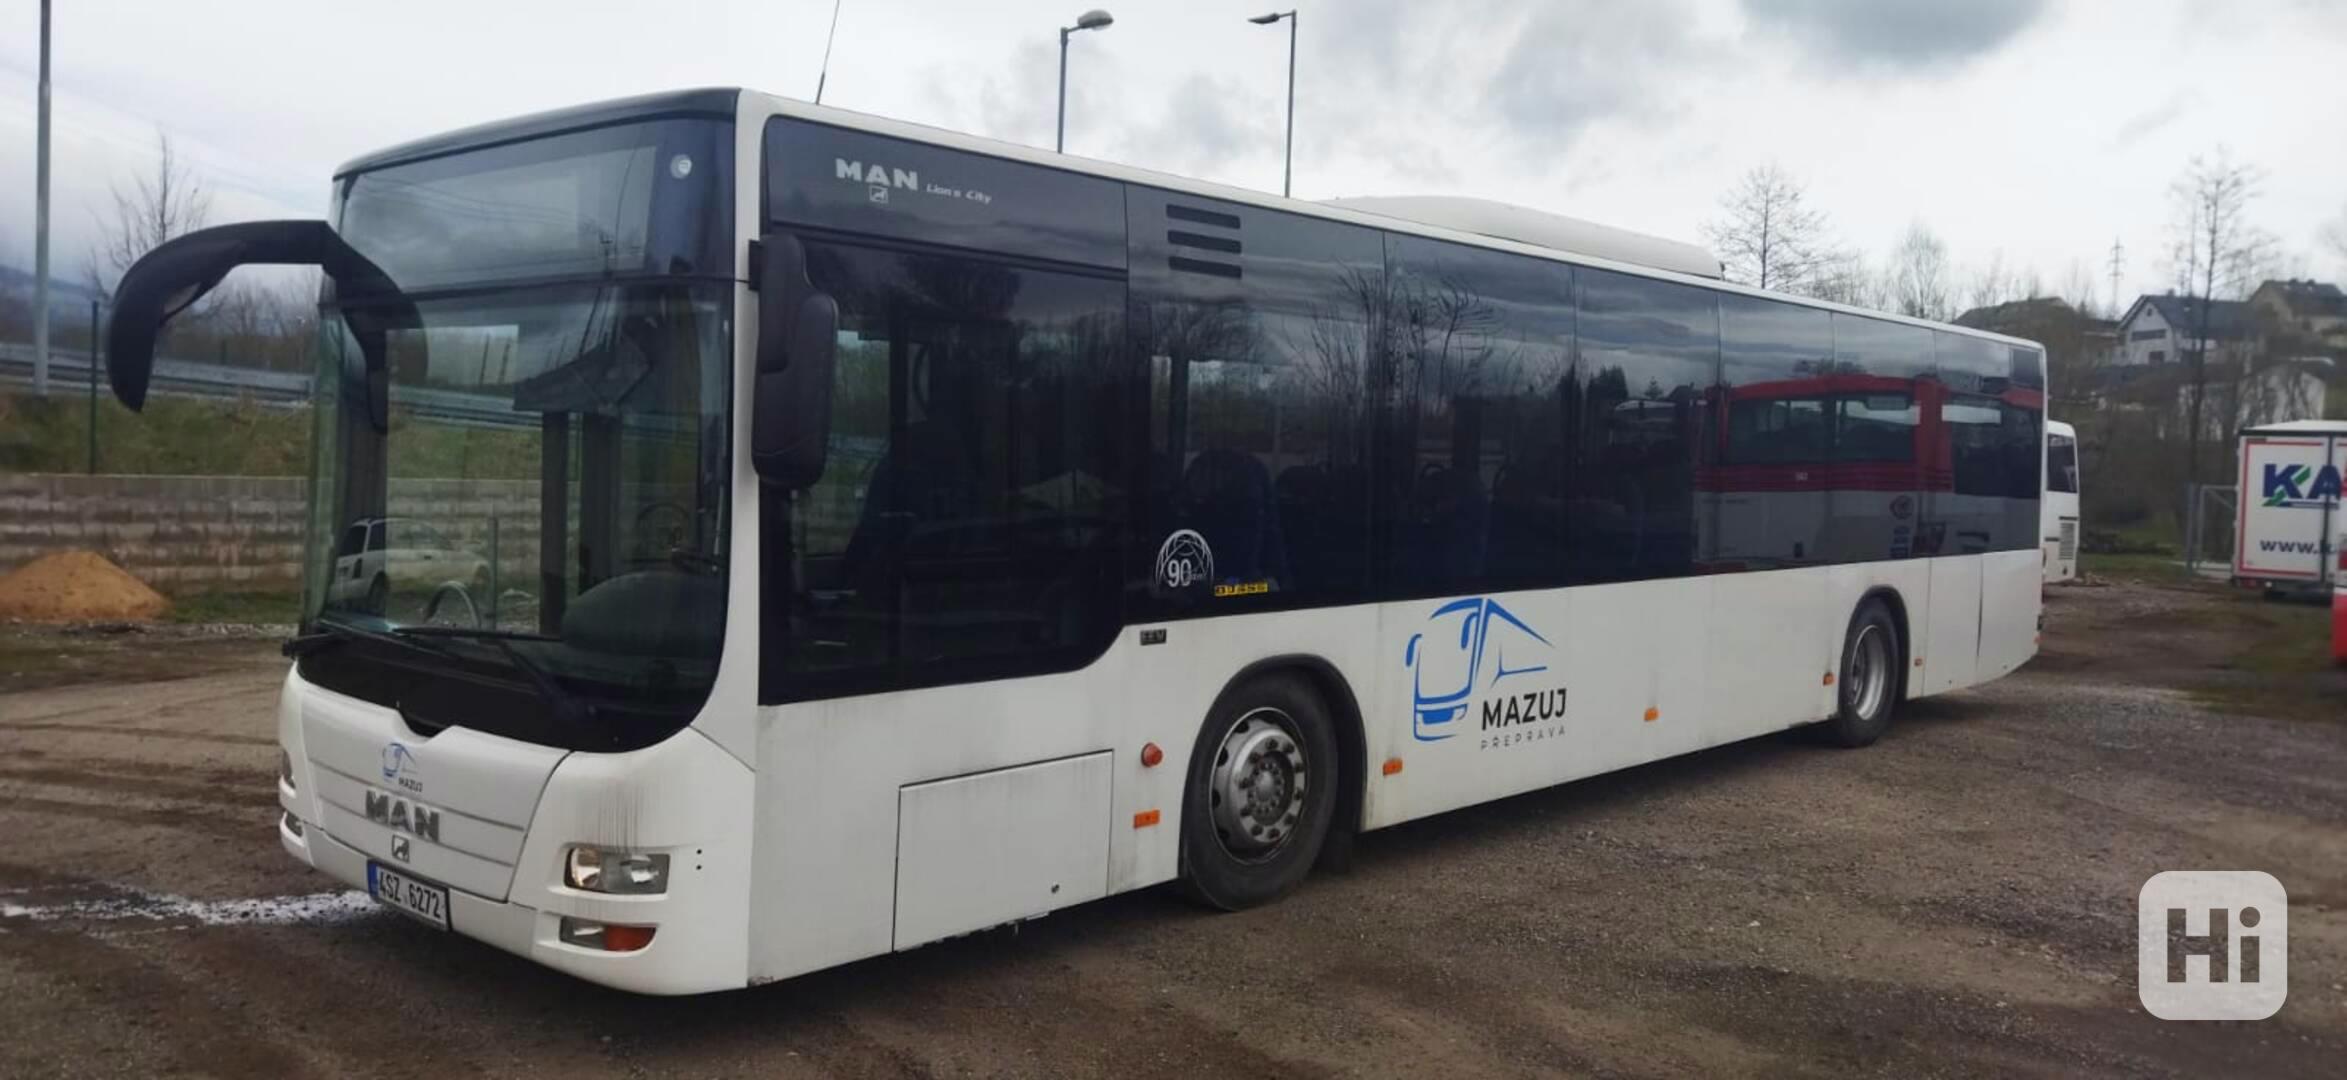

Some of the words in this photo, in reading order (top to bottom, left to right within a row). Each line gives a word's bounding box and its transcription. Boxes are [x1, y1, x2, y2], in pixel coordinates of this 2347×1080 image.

[835, 158, 918, 191] MAN
[926, 183, 961, 198] Lions
[965, 189, 993, 205] City
[1167, 559, 1192, 587] 90
[1481, 688, 1567, 731] MAZUJ
[398, 776, 423, 793] MAZUJ
[366, 790, 440, 844] MAN
[380, 871, 401, 902] 4SZ
[408, 883, 441, 918] 6272
